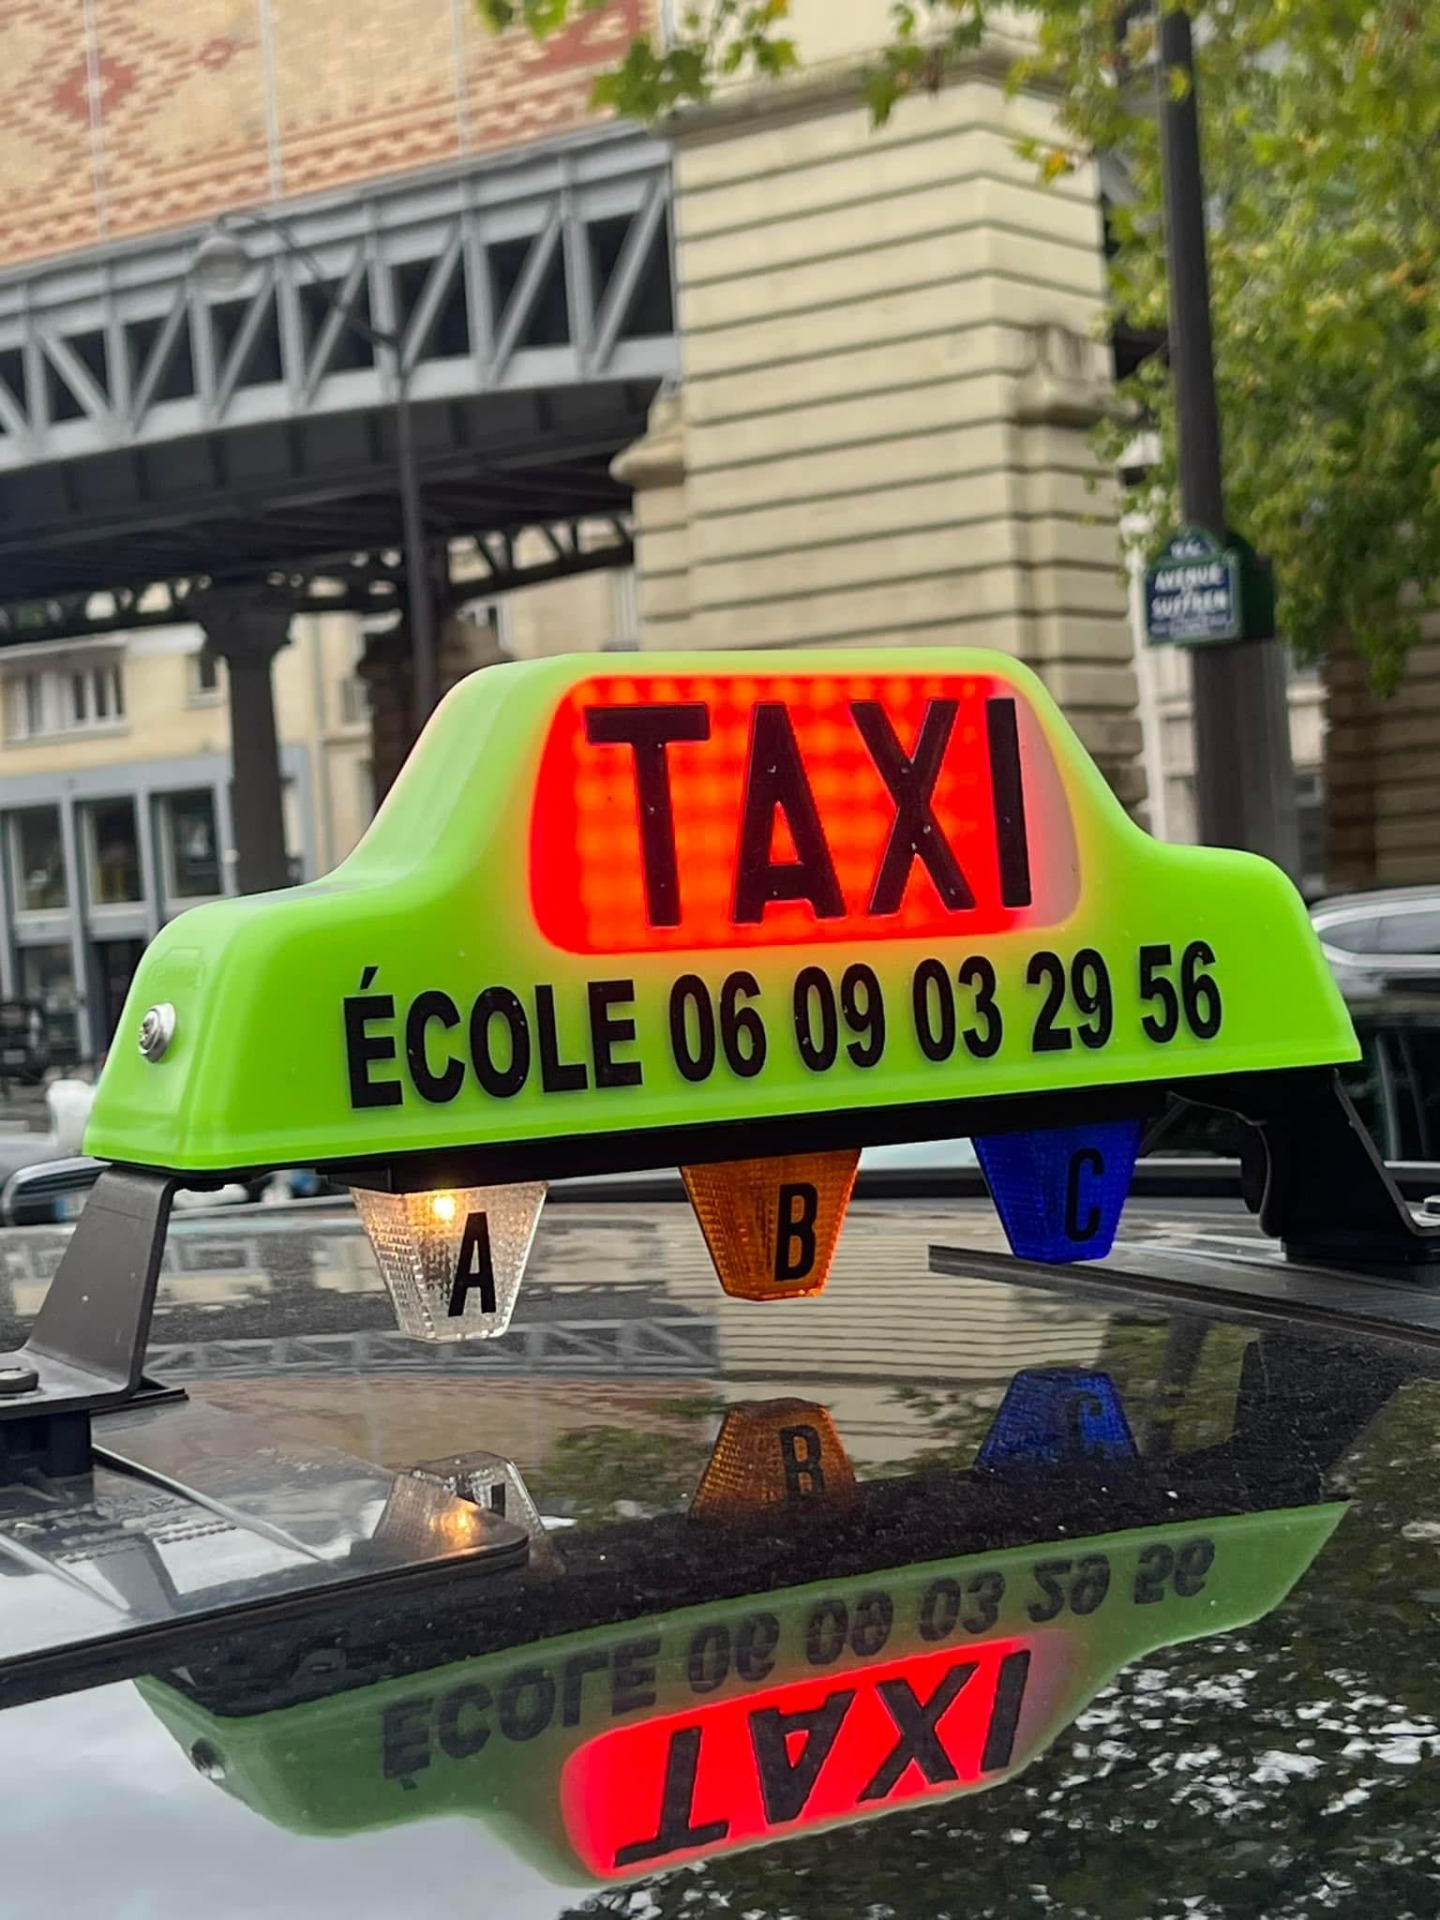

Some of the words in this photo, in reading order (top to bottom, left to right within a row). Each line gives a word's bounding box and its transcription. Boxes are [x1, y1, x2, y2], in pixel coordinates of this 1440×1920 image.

[1155, 562, 1223, 591] AVENUE
[583, 697, 1032, 927] TAXI
[344, 966, 643, 1109] ÉCOLE
[669, 971, 767, 1082] 06
[793, 963, 886, 1072] 09
[912, 956, 1003, 1062] 03
[1026, 949, 1113, 1052] 29
[1139, 940, 1223, 1044] 56
[774, 1183, 818, 1283] B
[1064, 1148, 1104, 1242] C
[448, 1211, 497, 1317] A
